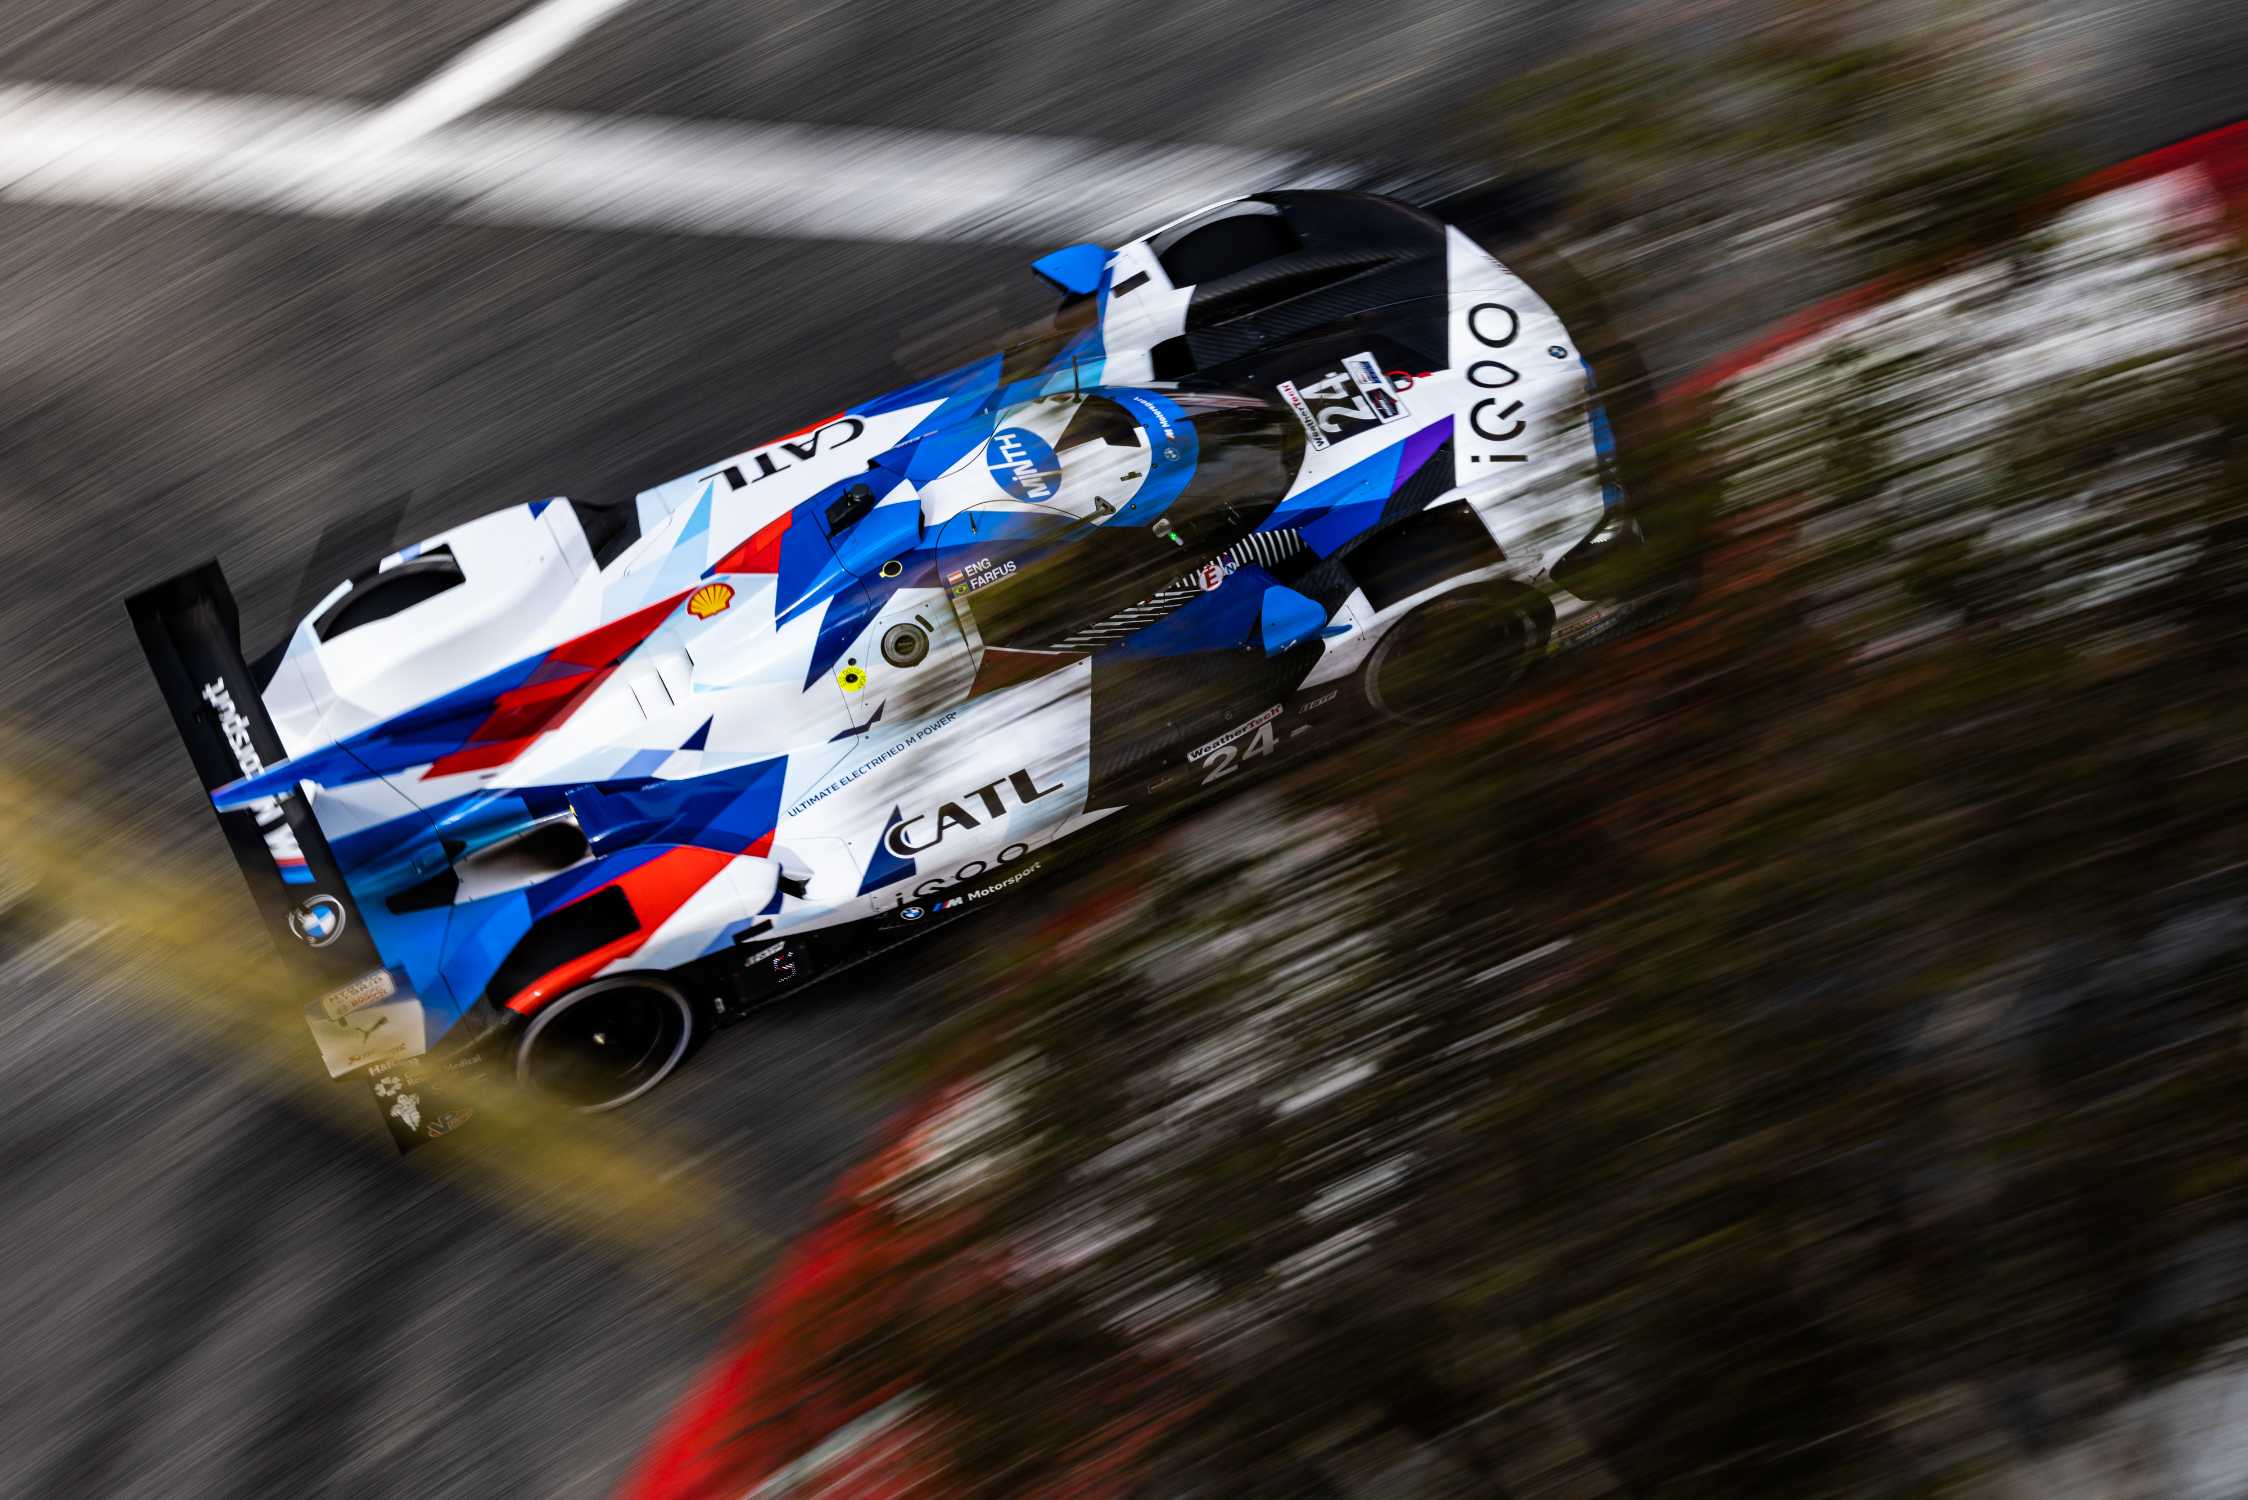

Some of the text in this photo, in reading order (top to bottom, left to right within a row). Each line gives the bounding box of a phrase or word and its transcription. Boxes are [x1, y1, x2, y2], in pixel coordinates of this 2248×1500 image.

[1300, 372, 1377, 433] 24
[698, 418, 864, 491] CATL
[965, 558, 992, 577] ENG
[970, 561, 1017, 589] FARFUS
[202, 677, 285, 827] Morsport
[1190, 704, 1281, 760] WeatherTech
[1201, 721, 1279, 785] 24
[787, 783, 840, 817] ULTIMATE
[840, 743, 905, 787] ELECTRIFIED
[905, 737, 917, 747] M
[888, 768, 1064, 856] CATL
[968, 861, 1042, 901] Motorsport
